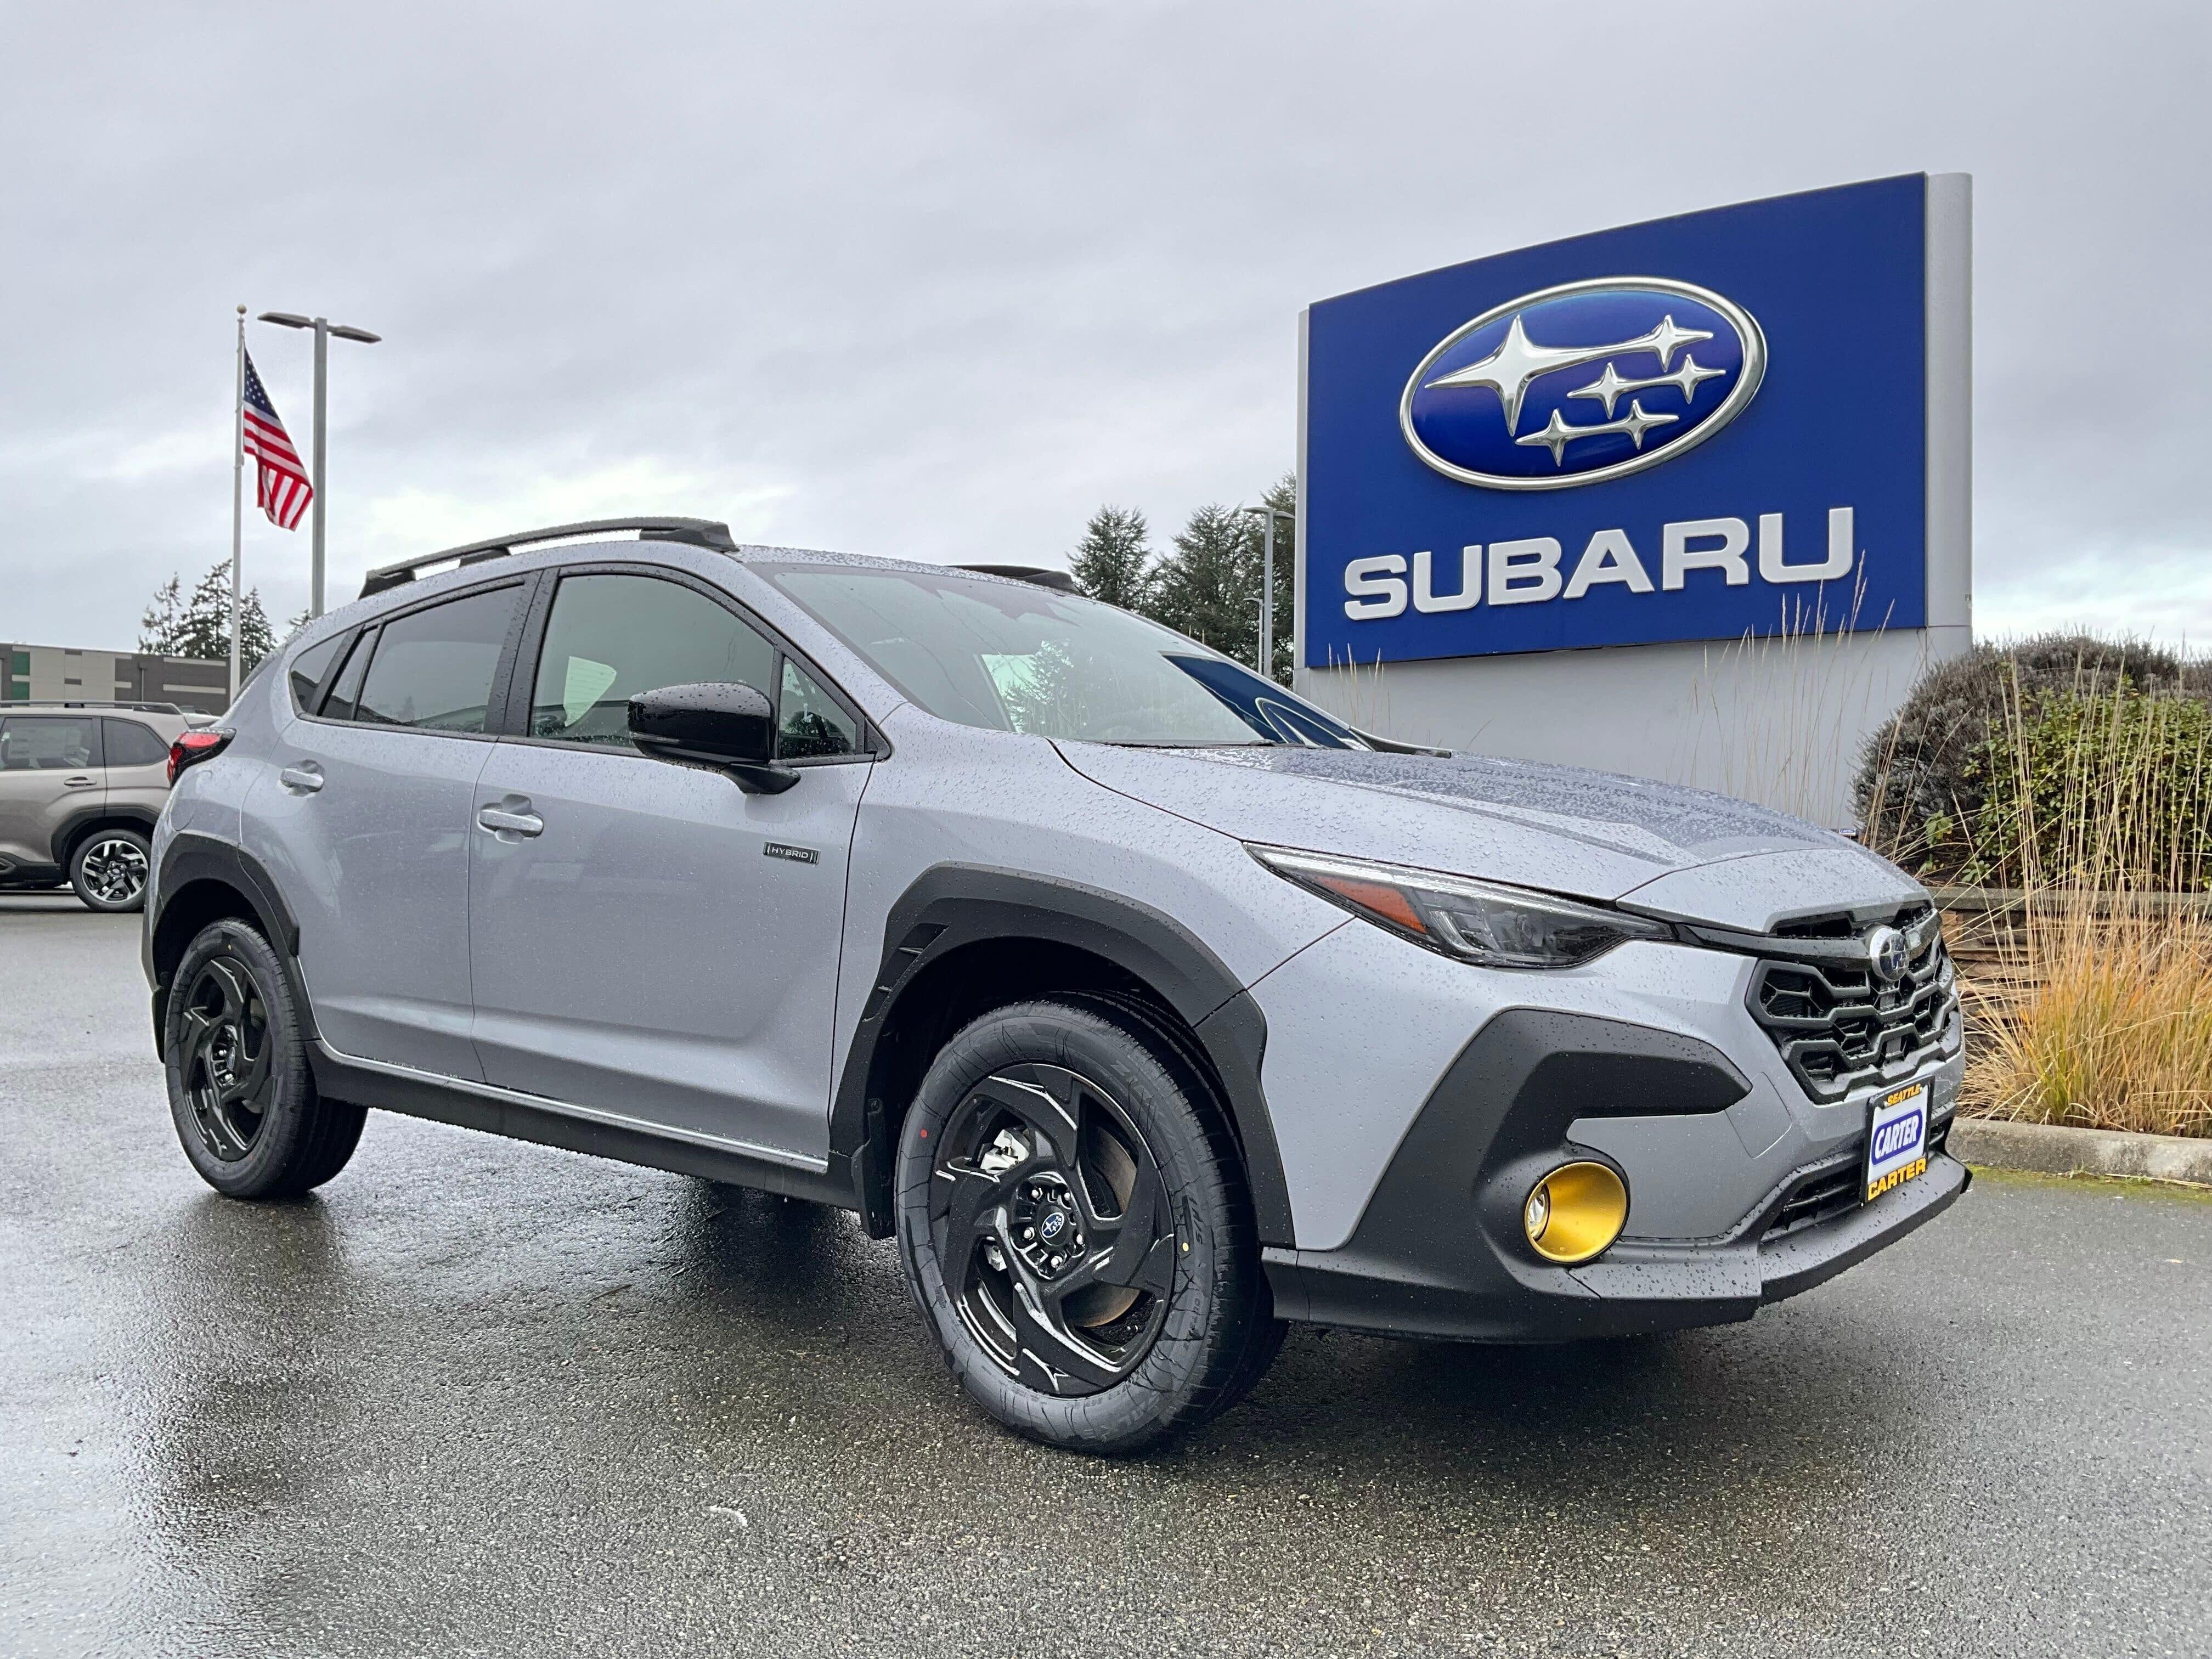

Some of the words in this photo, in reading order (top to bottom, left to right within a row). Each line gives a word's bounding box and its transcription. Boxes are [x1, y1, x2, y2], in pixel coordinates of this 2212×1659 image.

[1345, 506, 1853, 620] SUBARU
[771, 847, 809, 858] HYBRID
[1887, 1084, 1921, 1106] SEATTLE
[1875, 1115, 1919, 1158] CARTER
[1868, 1158, 1926, 1201] CARTER
